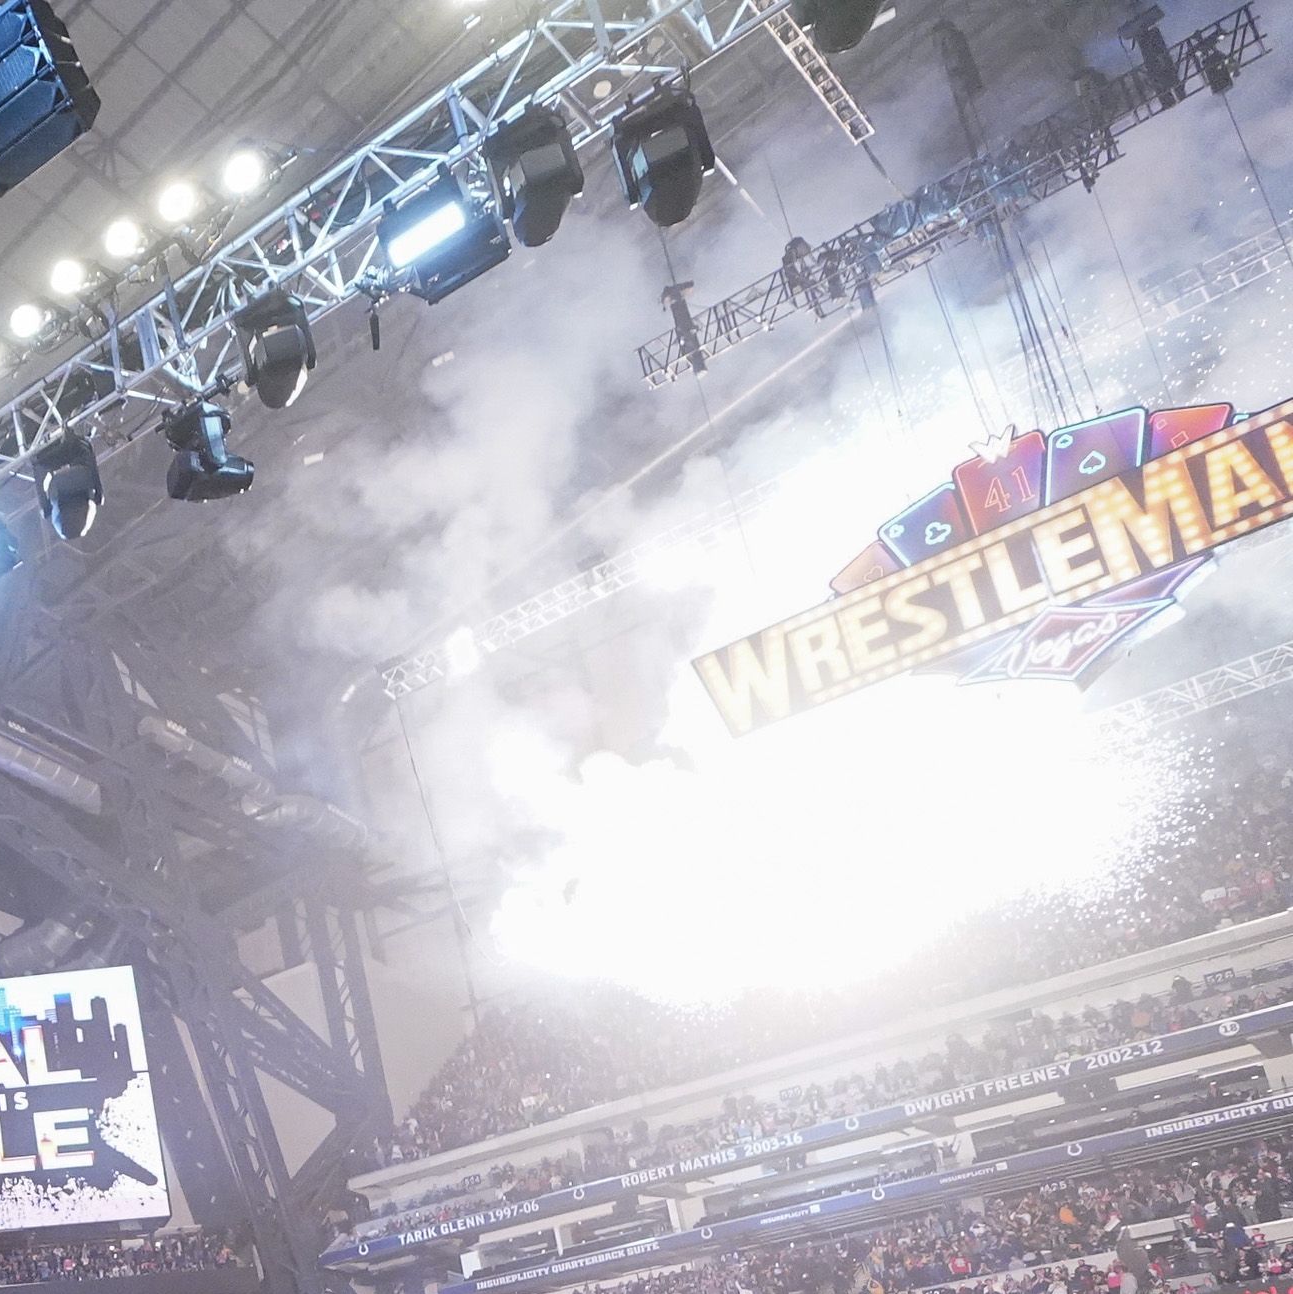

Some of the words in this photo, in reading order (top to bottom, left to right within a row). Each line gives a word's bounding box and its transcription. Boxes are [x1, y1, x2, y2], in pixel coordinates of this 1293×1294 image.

[983, 467, 1036, 512] 41
[904, 1087, 978, 1116] DWIGHT
[983, 1062, 1072, 1097] FREENEY
[1085, 1040, 1164, 1071] 2002-12
[1144, 1102, 1268, 1138] INSUREPLICITY
[621, 1167, 675, 1188] ROBERT
[680, 1149, 736, 1174] MATHIS
[744, 1133, 803, 1157] 2003-16
[398, 1227, 437, 1246] TARIK
[440, 1214, 485, 1235] GLENN
[489, 1201, 539, 1224] 1997-06
[476, 1267, 550, 1291] INSUREPLICITY
[551, 1250, 626, 1274] QUARTERBACK
[627, 1242, 659, 1257] SUITE
